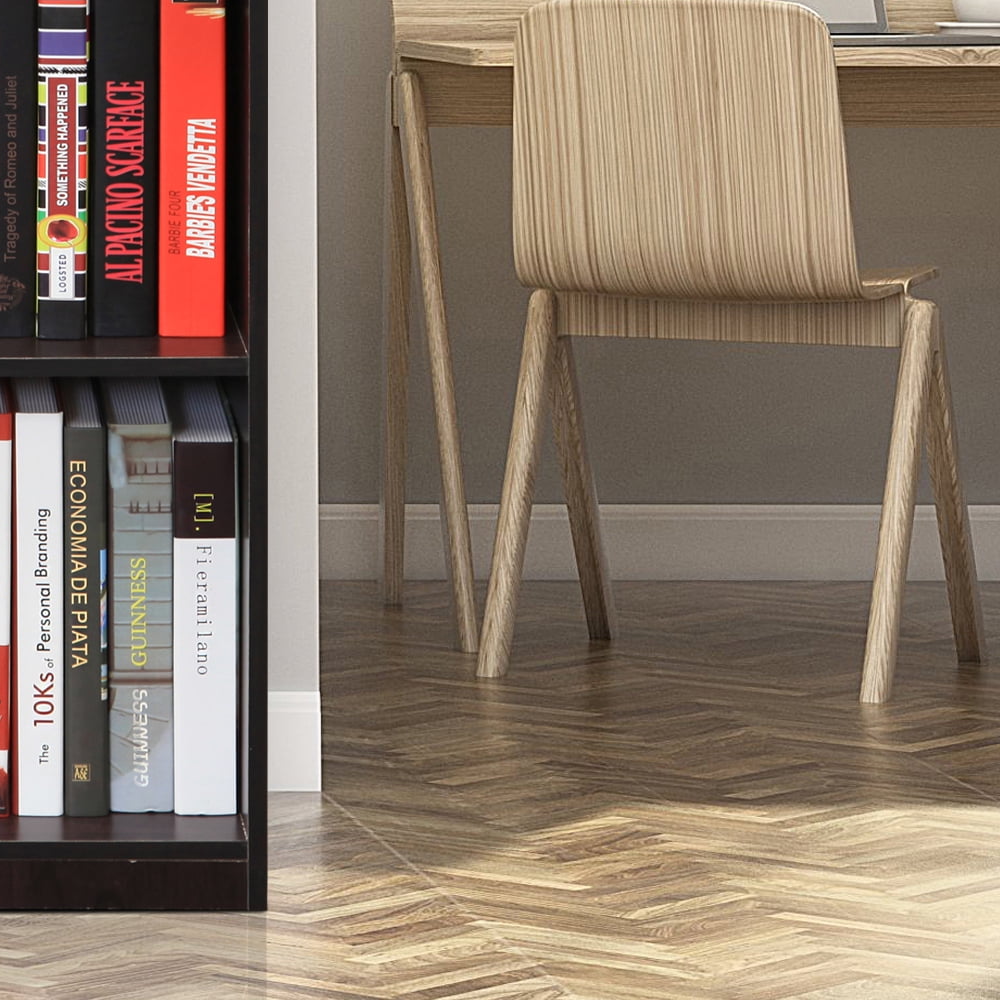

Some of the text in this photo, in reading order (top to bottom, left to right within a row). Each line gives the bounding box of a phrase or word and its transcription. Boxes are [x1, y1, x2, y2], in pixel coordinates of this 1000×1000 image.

[4, 75, 19, 262] Tragedy of Romeo and Juliet
[56, 83, 69, 206] SOMETHING HAPPENED
[105, 81, 145, 284] AL PACINO SCARFACE
[186, 118, 217, 259] BARBIES VENDETTA
[58, 254, 67, 293] LOGSTED
[168, 190, 181, 255] BARBIE FOUR
[70, 460, 88, 668] ECONOMIA DE PIATA
[130, 557, 147, 667] GUINNESS
[33, 508, 54, 764] The 10Ks of Personal Branding
[132, 689, 149, 788] GUINNESS
